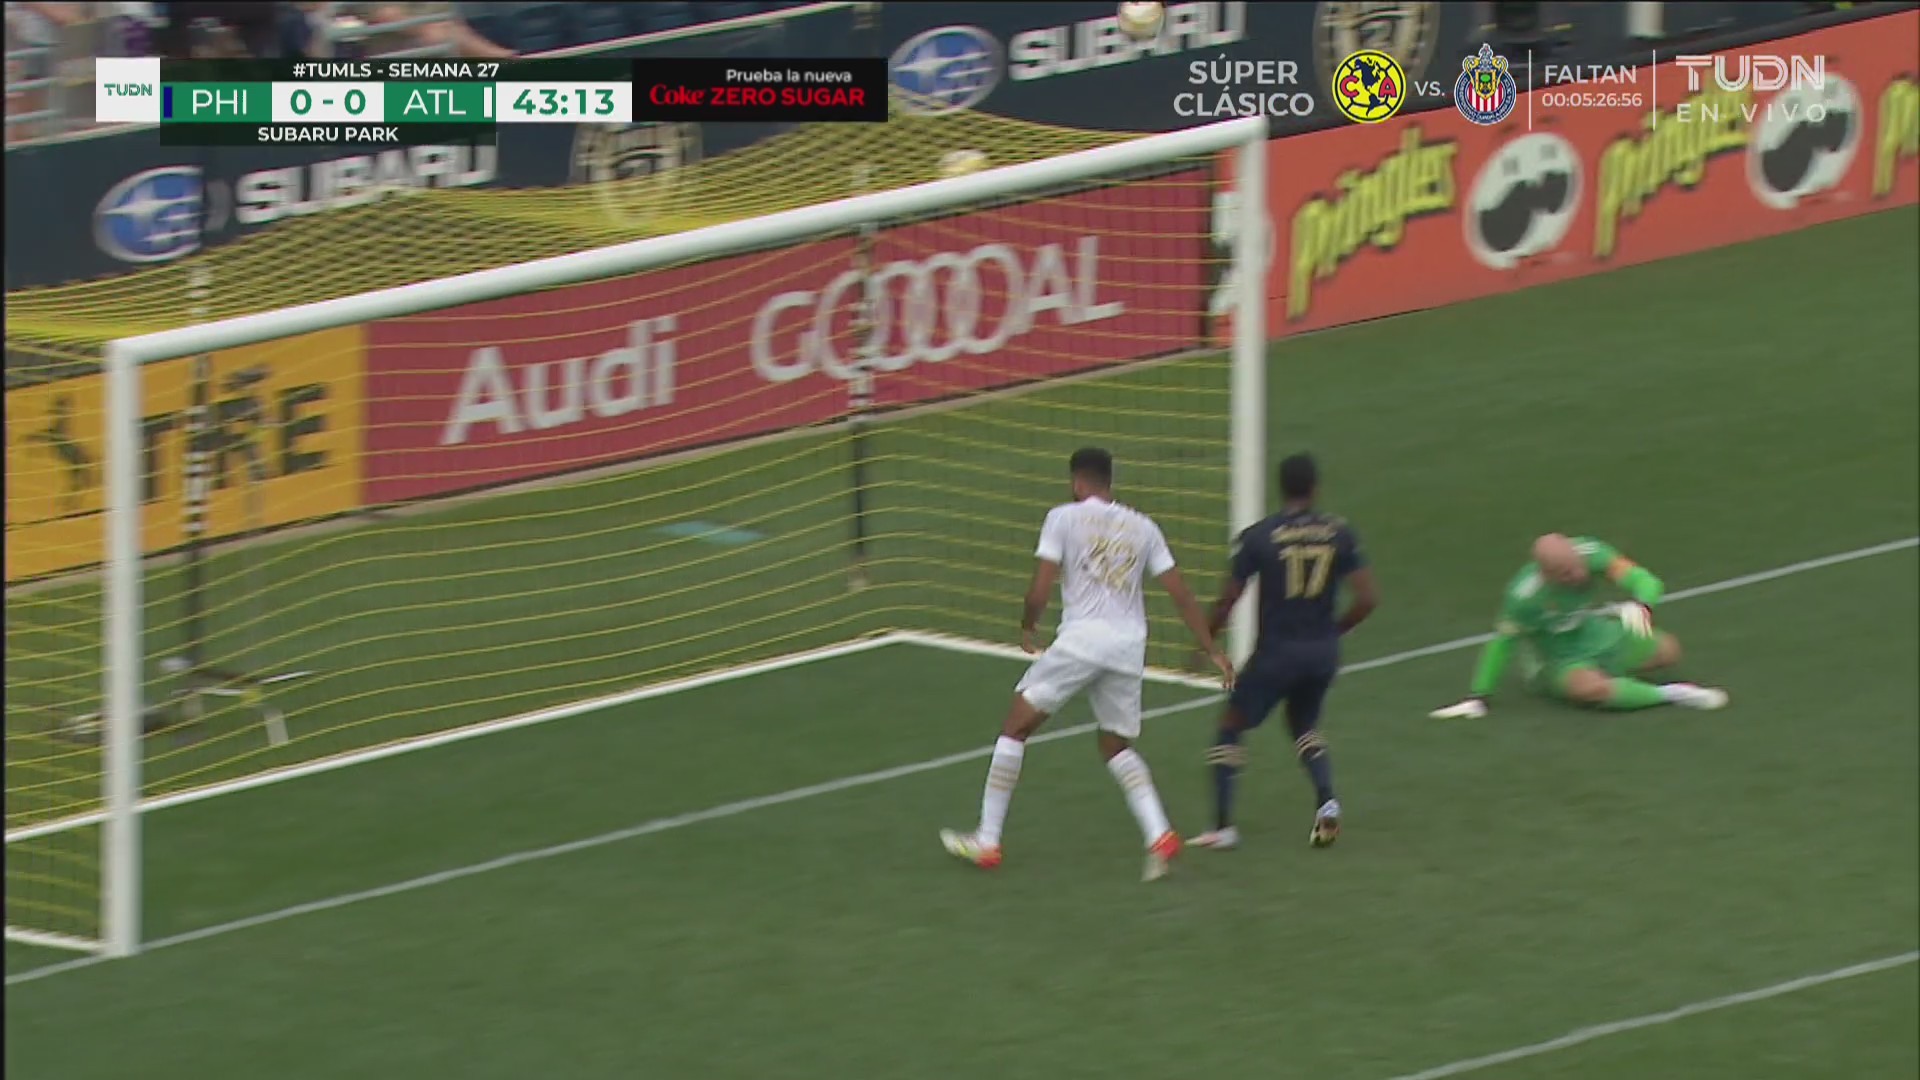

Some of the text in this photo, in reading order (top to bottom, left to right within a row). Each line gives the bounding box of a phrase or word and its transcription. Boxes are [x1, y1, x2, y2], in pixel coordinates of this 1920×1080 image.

[1008, 1, 1247, 81] SUBRU
[440, 315, 677, 445] Audi
[1279, 544, 1335, 599] 17
